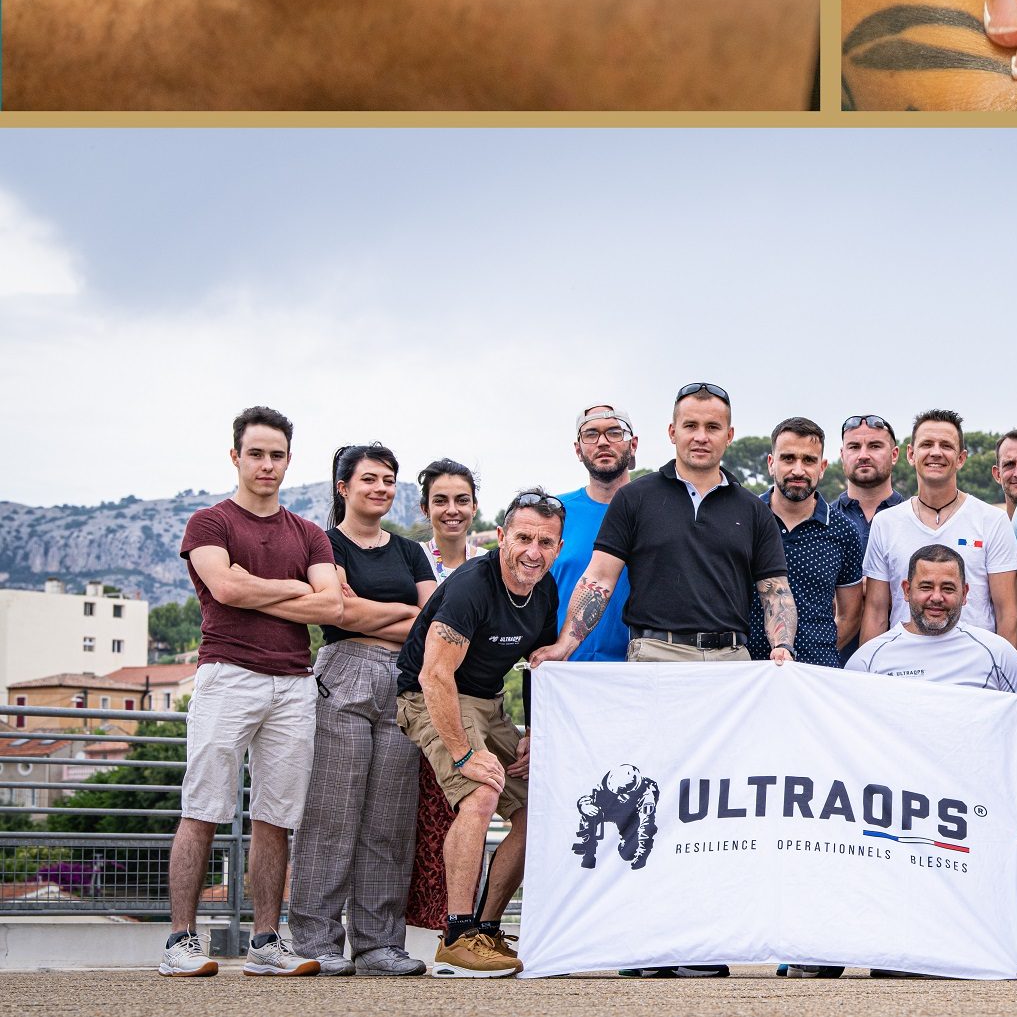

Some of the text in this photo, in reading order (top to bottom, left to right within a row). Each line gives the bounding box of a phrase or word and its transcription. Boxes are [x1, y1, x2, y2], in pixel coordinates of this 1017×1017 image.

[675, 839, 969, 874] RESILIENCE OPERATIONNELS BLESSES
